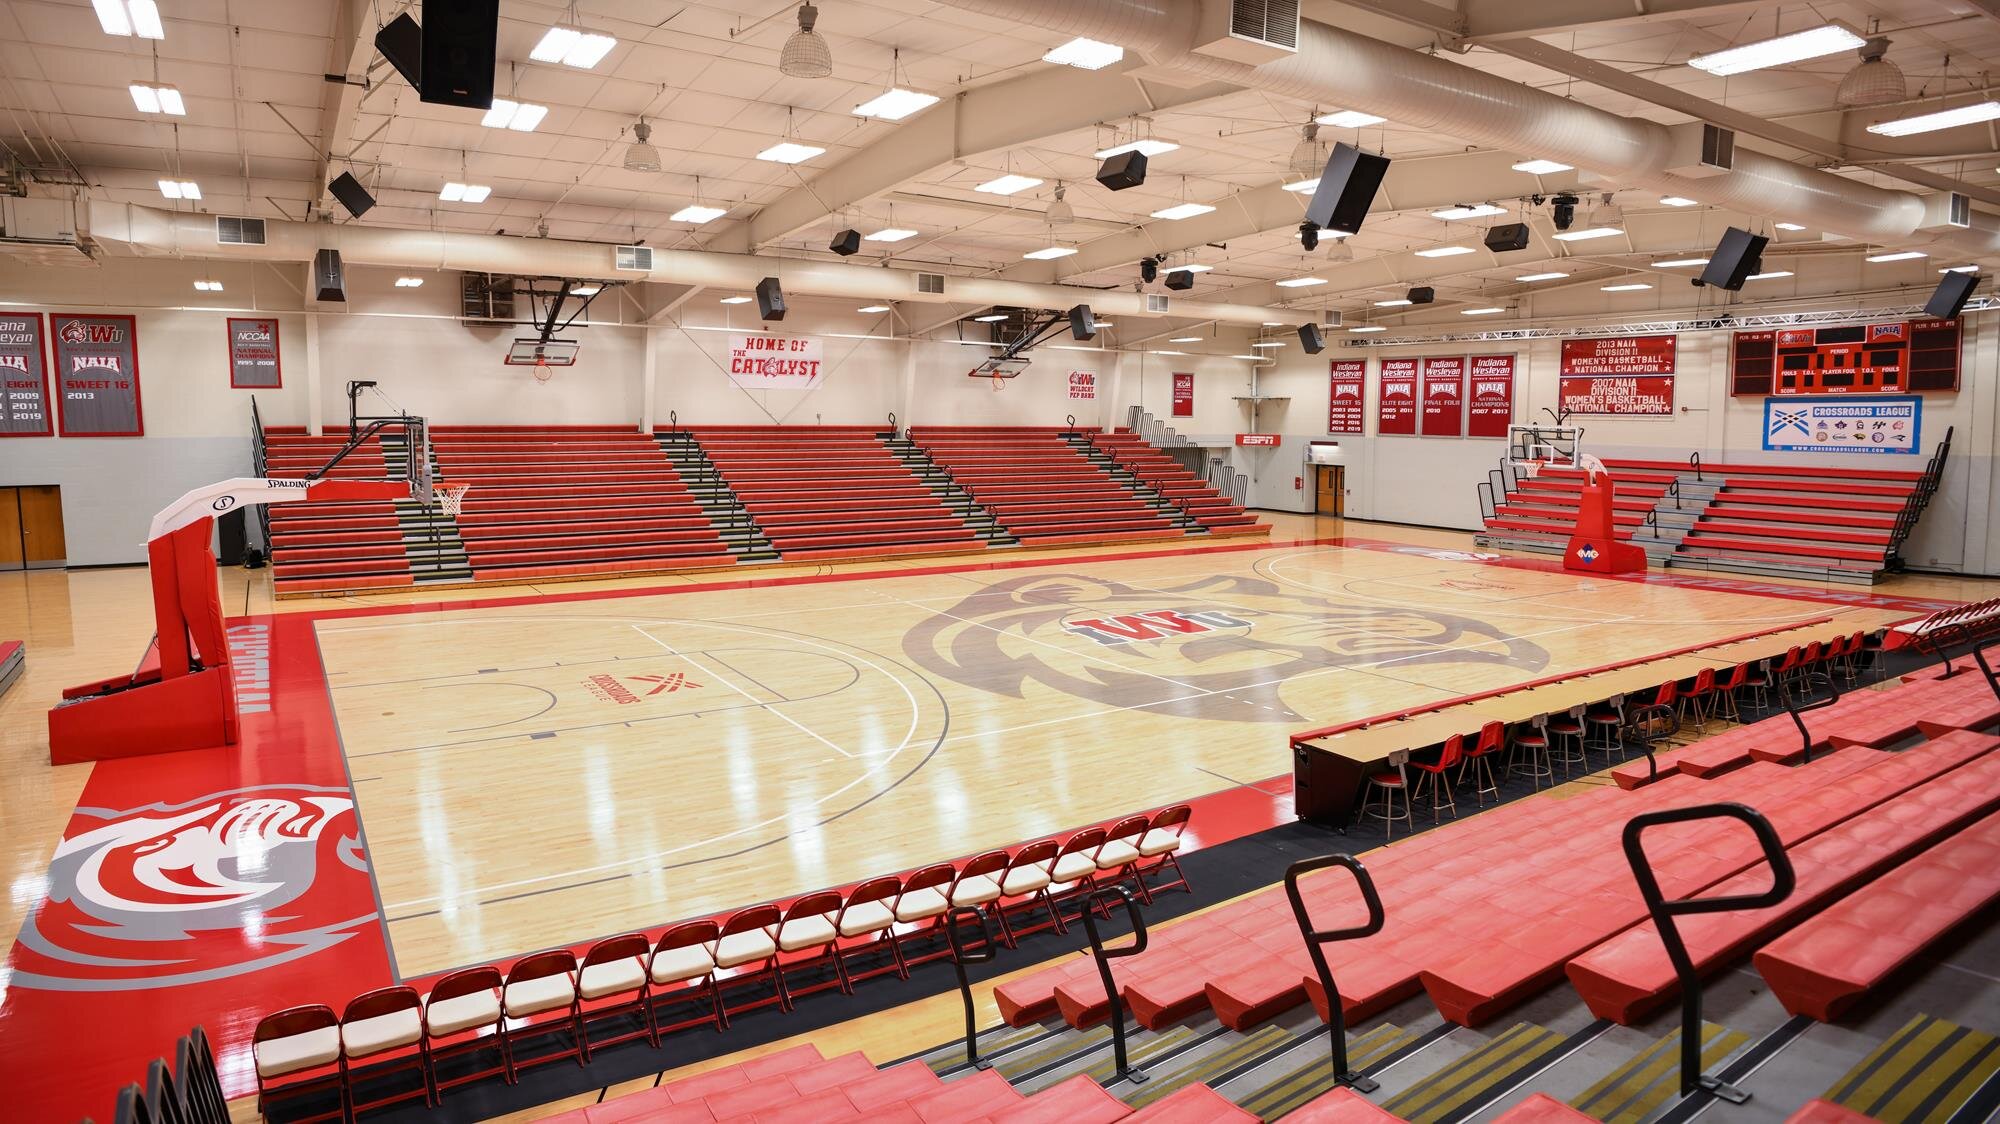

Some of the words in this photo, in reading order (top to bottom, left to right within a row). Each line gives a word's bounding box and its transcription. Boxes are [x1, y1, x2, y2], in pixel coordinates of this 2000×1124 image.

[1874, 324, 1901, 335] NAIA
[746, 338, 785, 351] HOME
[791, 340, 808, 352] OF
[1595, 348, 1630, 357] DIVISION
[1478, 359, 1507, 367] Indiana
[1571, 357, 1606, 365] WOMEN'S
[1609, 355, 1663, 364] BASKETBALL
[73, 357, 120, 373] NAIA
[732, 358, 819, 379] CATLYST
[1575, 365, 1613, 374] NATIONAL
[1615, 364, 1658, 373] CHAMPION
[1382, 370, 1415, 378] Wesleyan
[1426, 368, 1461, 376] Wesleyan
[1473, 367, 1510, 375] Wesleyan
[66, 381, 109, 389] SWEET
[115, 381, 129, 389] 16
[1592, 379, 1613, 387] 2007
[1615, 378, 1637, 387] NAIA
[1337, 385, 1358, 396] NAIA
[1387, 384, 1410, 396] NAIA
[1431, 384, 1455, 394] NAIA
[1478, 382, 1503, 395] NAIA
[1591, 387, 1626, 396] DIVISION
[1628, 387, 1637, 395] II
[1565, 396, 1603, 404] WOMEN'S
[1606, 395, 1666, 404] BASKETBALL
[1569, 404, 1609, 413] NATIONAL
[1614, 404, 1662, 413] CHAMPION
[1814, 407, 1872, 416] CROSSROADS
[1876, 407, 1910, 416] LEAGUE
[1242, 436, 1274, 444] ESPN
[268, 480, 310, 488] SPALDING
[1063, 609, 1254, 646] IWU
